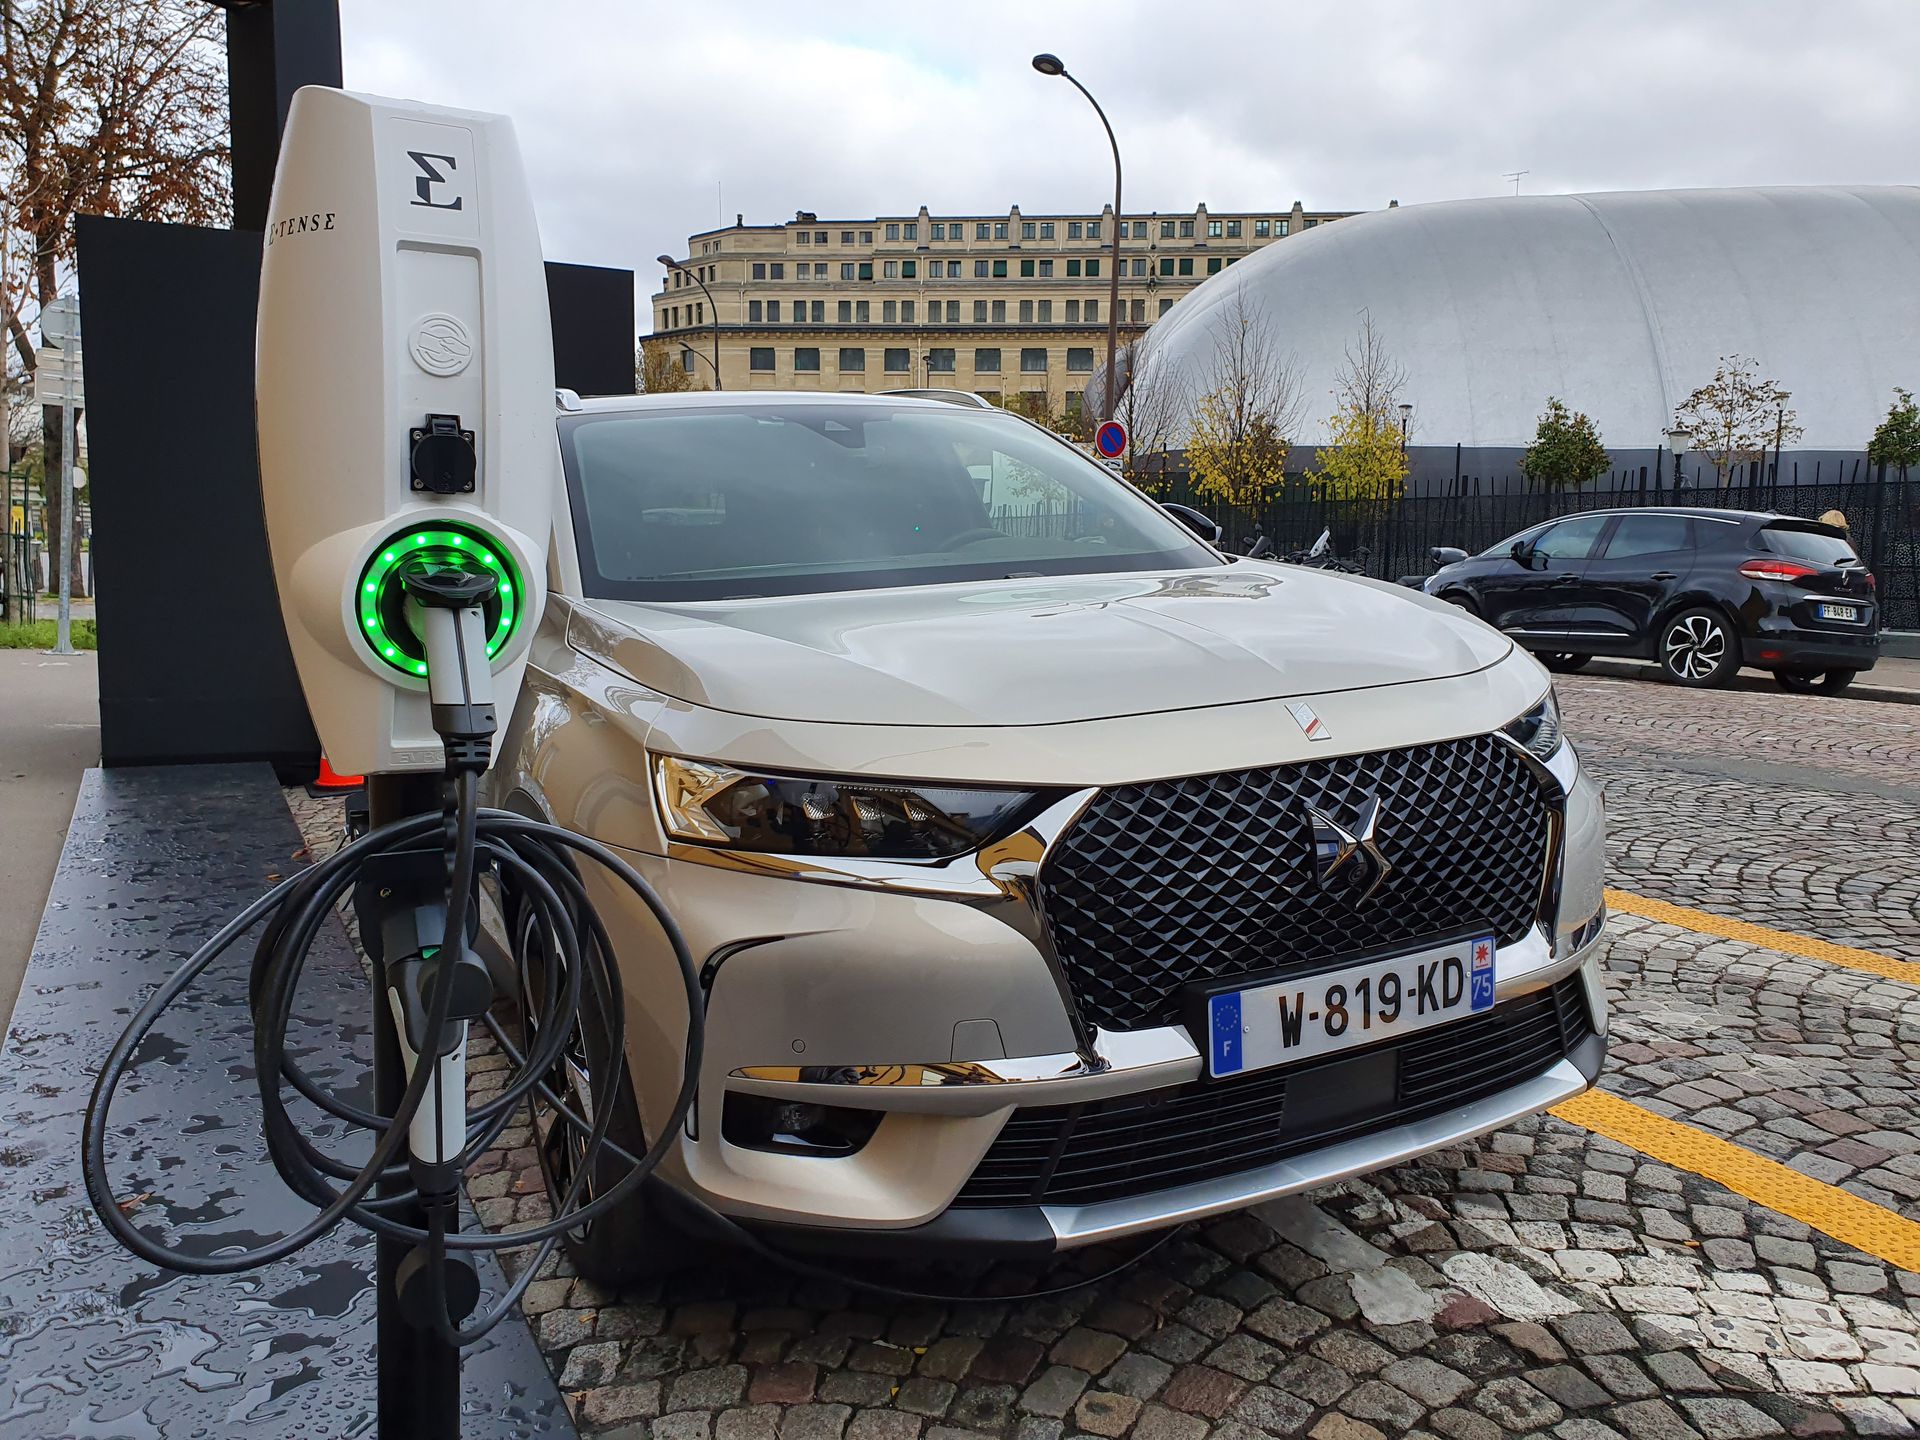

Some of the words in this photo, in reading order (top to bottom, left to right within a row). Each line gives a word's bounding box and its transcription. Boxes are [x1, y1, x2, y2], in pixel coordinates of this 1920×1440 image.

[1472, 973, 1492, 1001] 75
[1278, 956, 1465, 1049] W-819-KD
[1223, 1040, 1232, 1057] F
